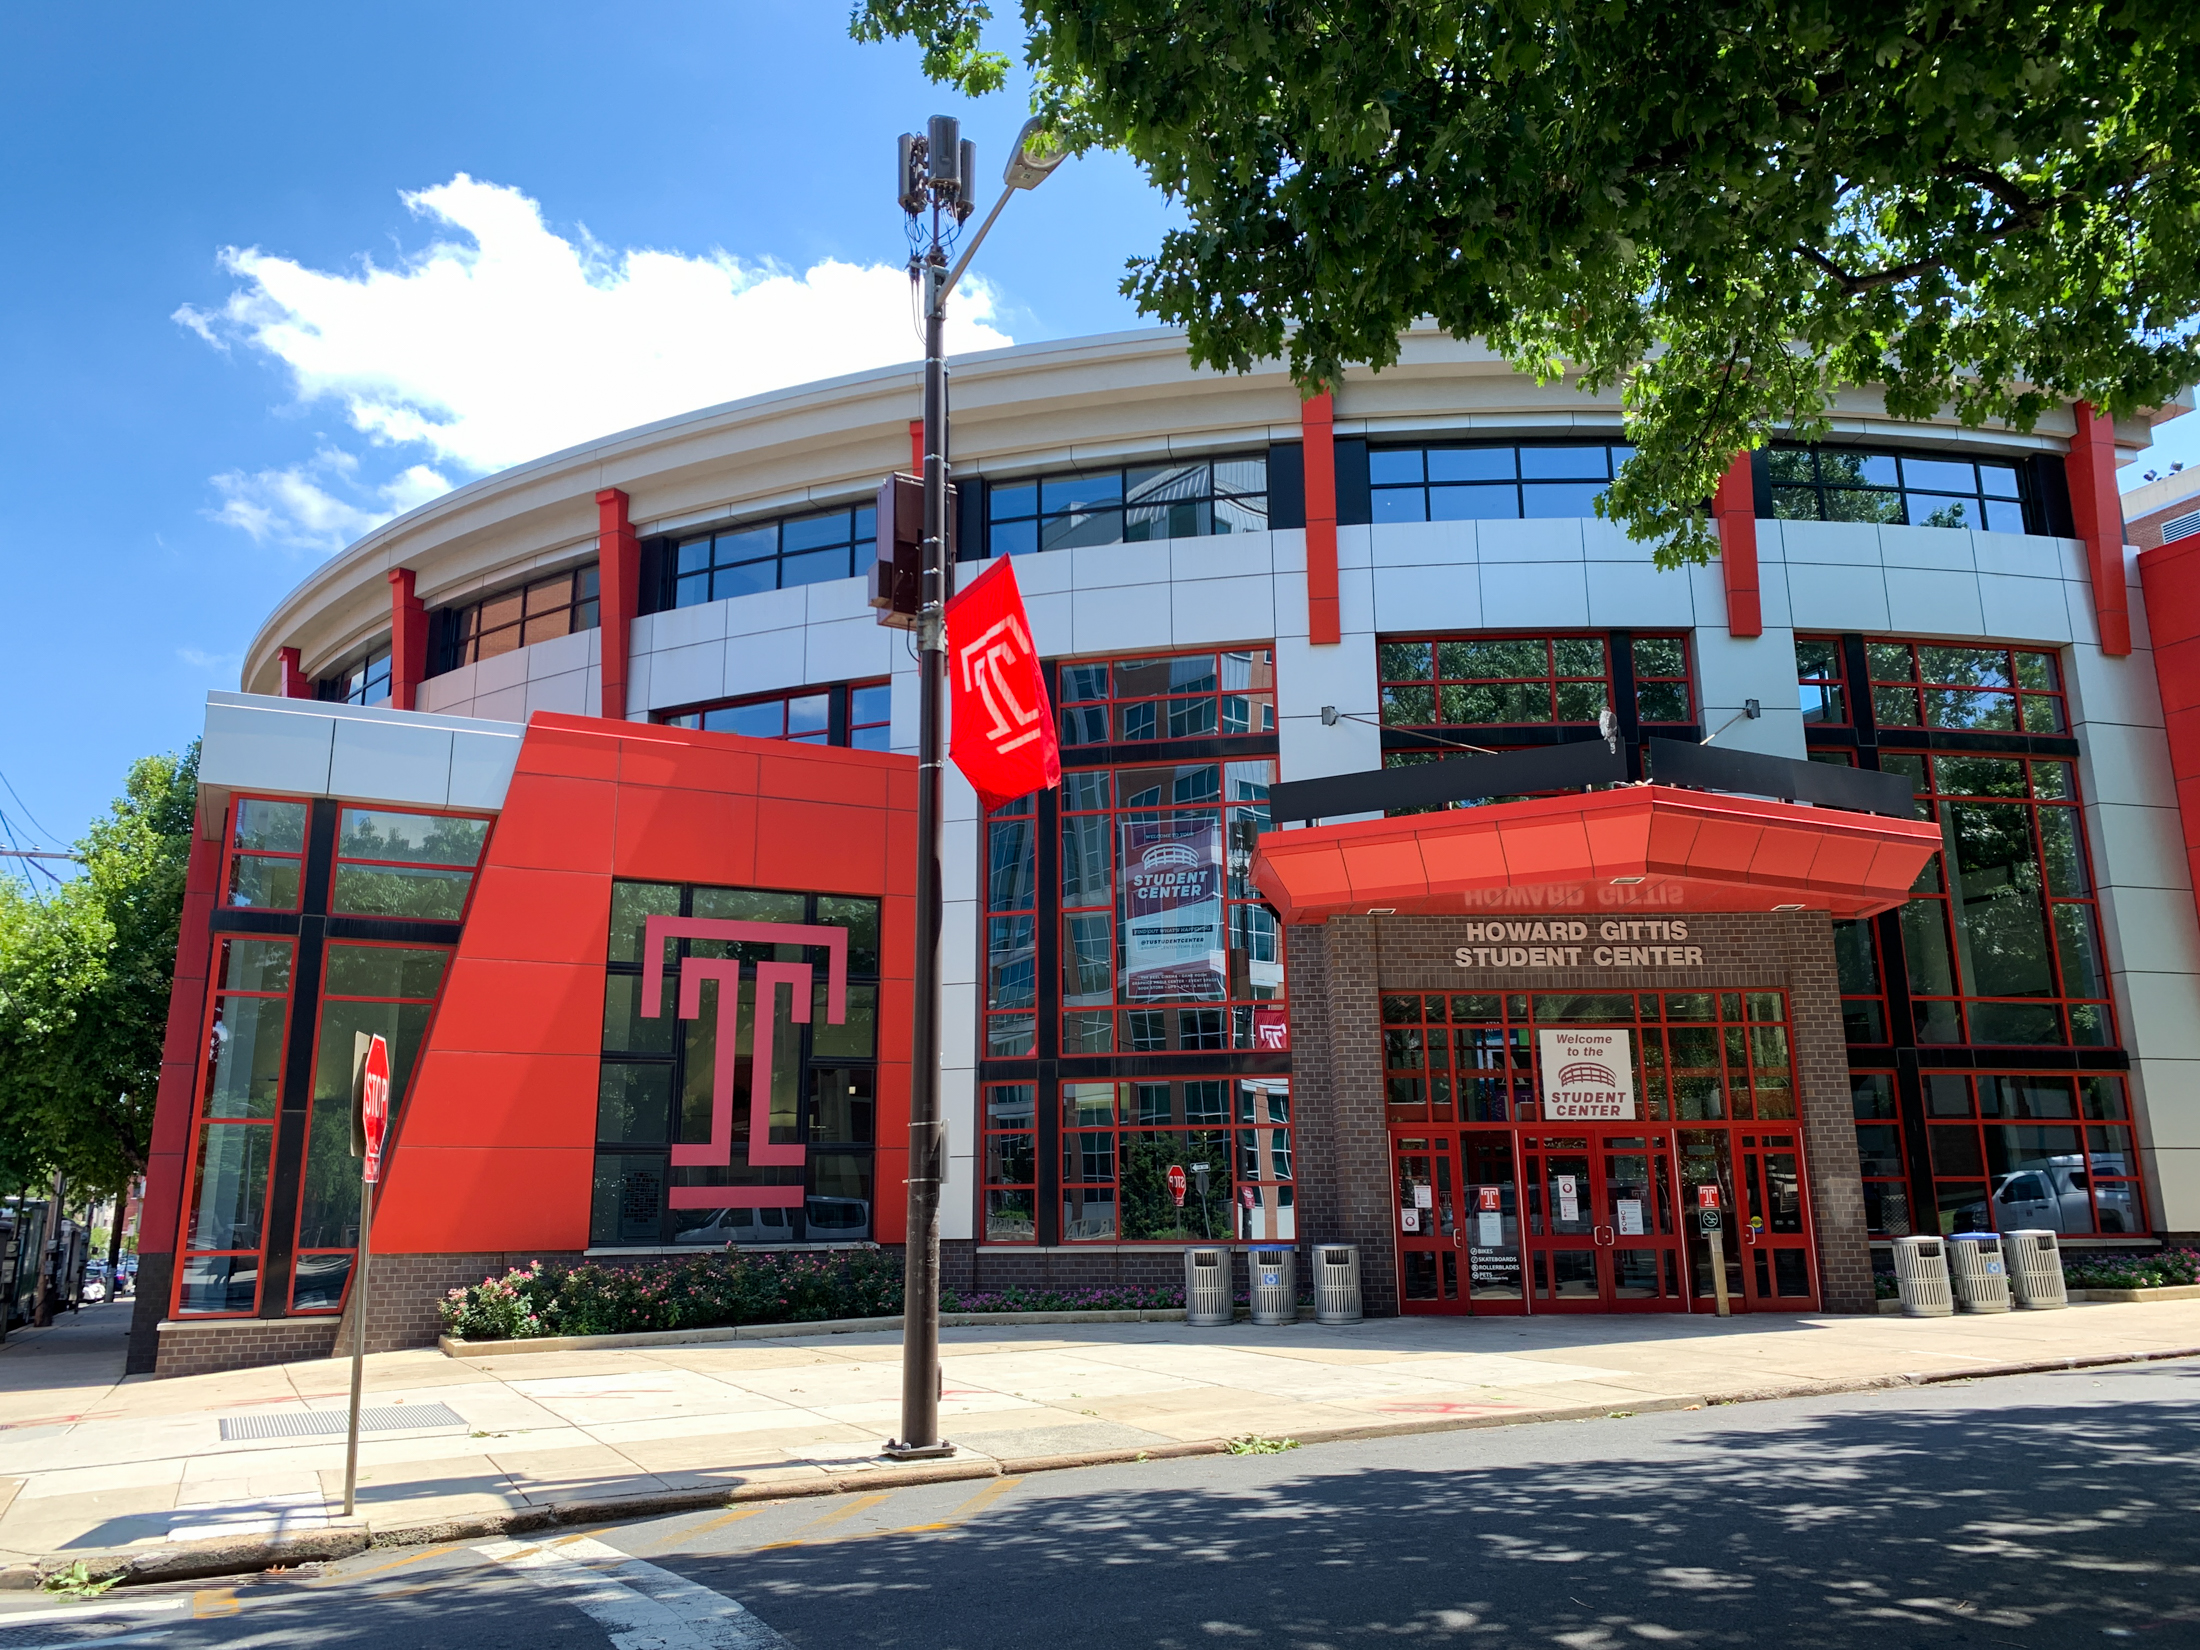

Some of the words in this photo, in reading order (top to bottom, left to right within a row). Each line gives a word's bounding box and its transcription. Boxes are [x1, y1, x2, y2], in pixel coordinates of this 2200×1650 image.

[1133, 871, 1208, 887] STUDENT
[1137, 884, 1202, 899] CENTER
[1466, 921, 1588, 942] HOWARD
[1600, 920, 1689, 941] GITTIS
[1140, 937, 1204, 946] @TUSTUDENTCENTER
[1455, 947, 1582, 968] STUDENT
[1593, 946, 1703, 967] CENTER
[1556, 1034, 1612, 1044] Welcome
[1567, 1047, 1579, 1057] to
[1583, 1047, 1603, 1057] the
[366, 1072, 388, 1119] STOP
[1551, 1092, 1627, 1104] STUDENT
[1556, 1105, 1621, 1116] CENTER
